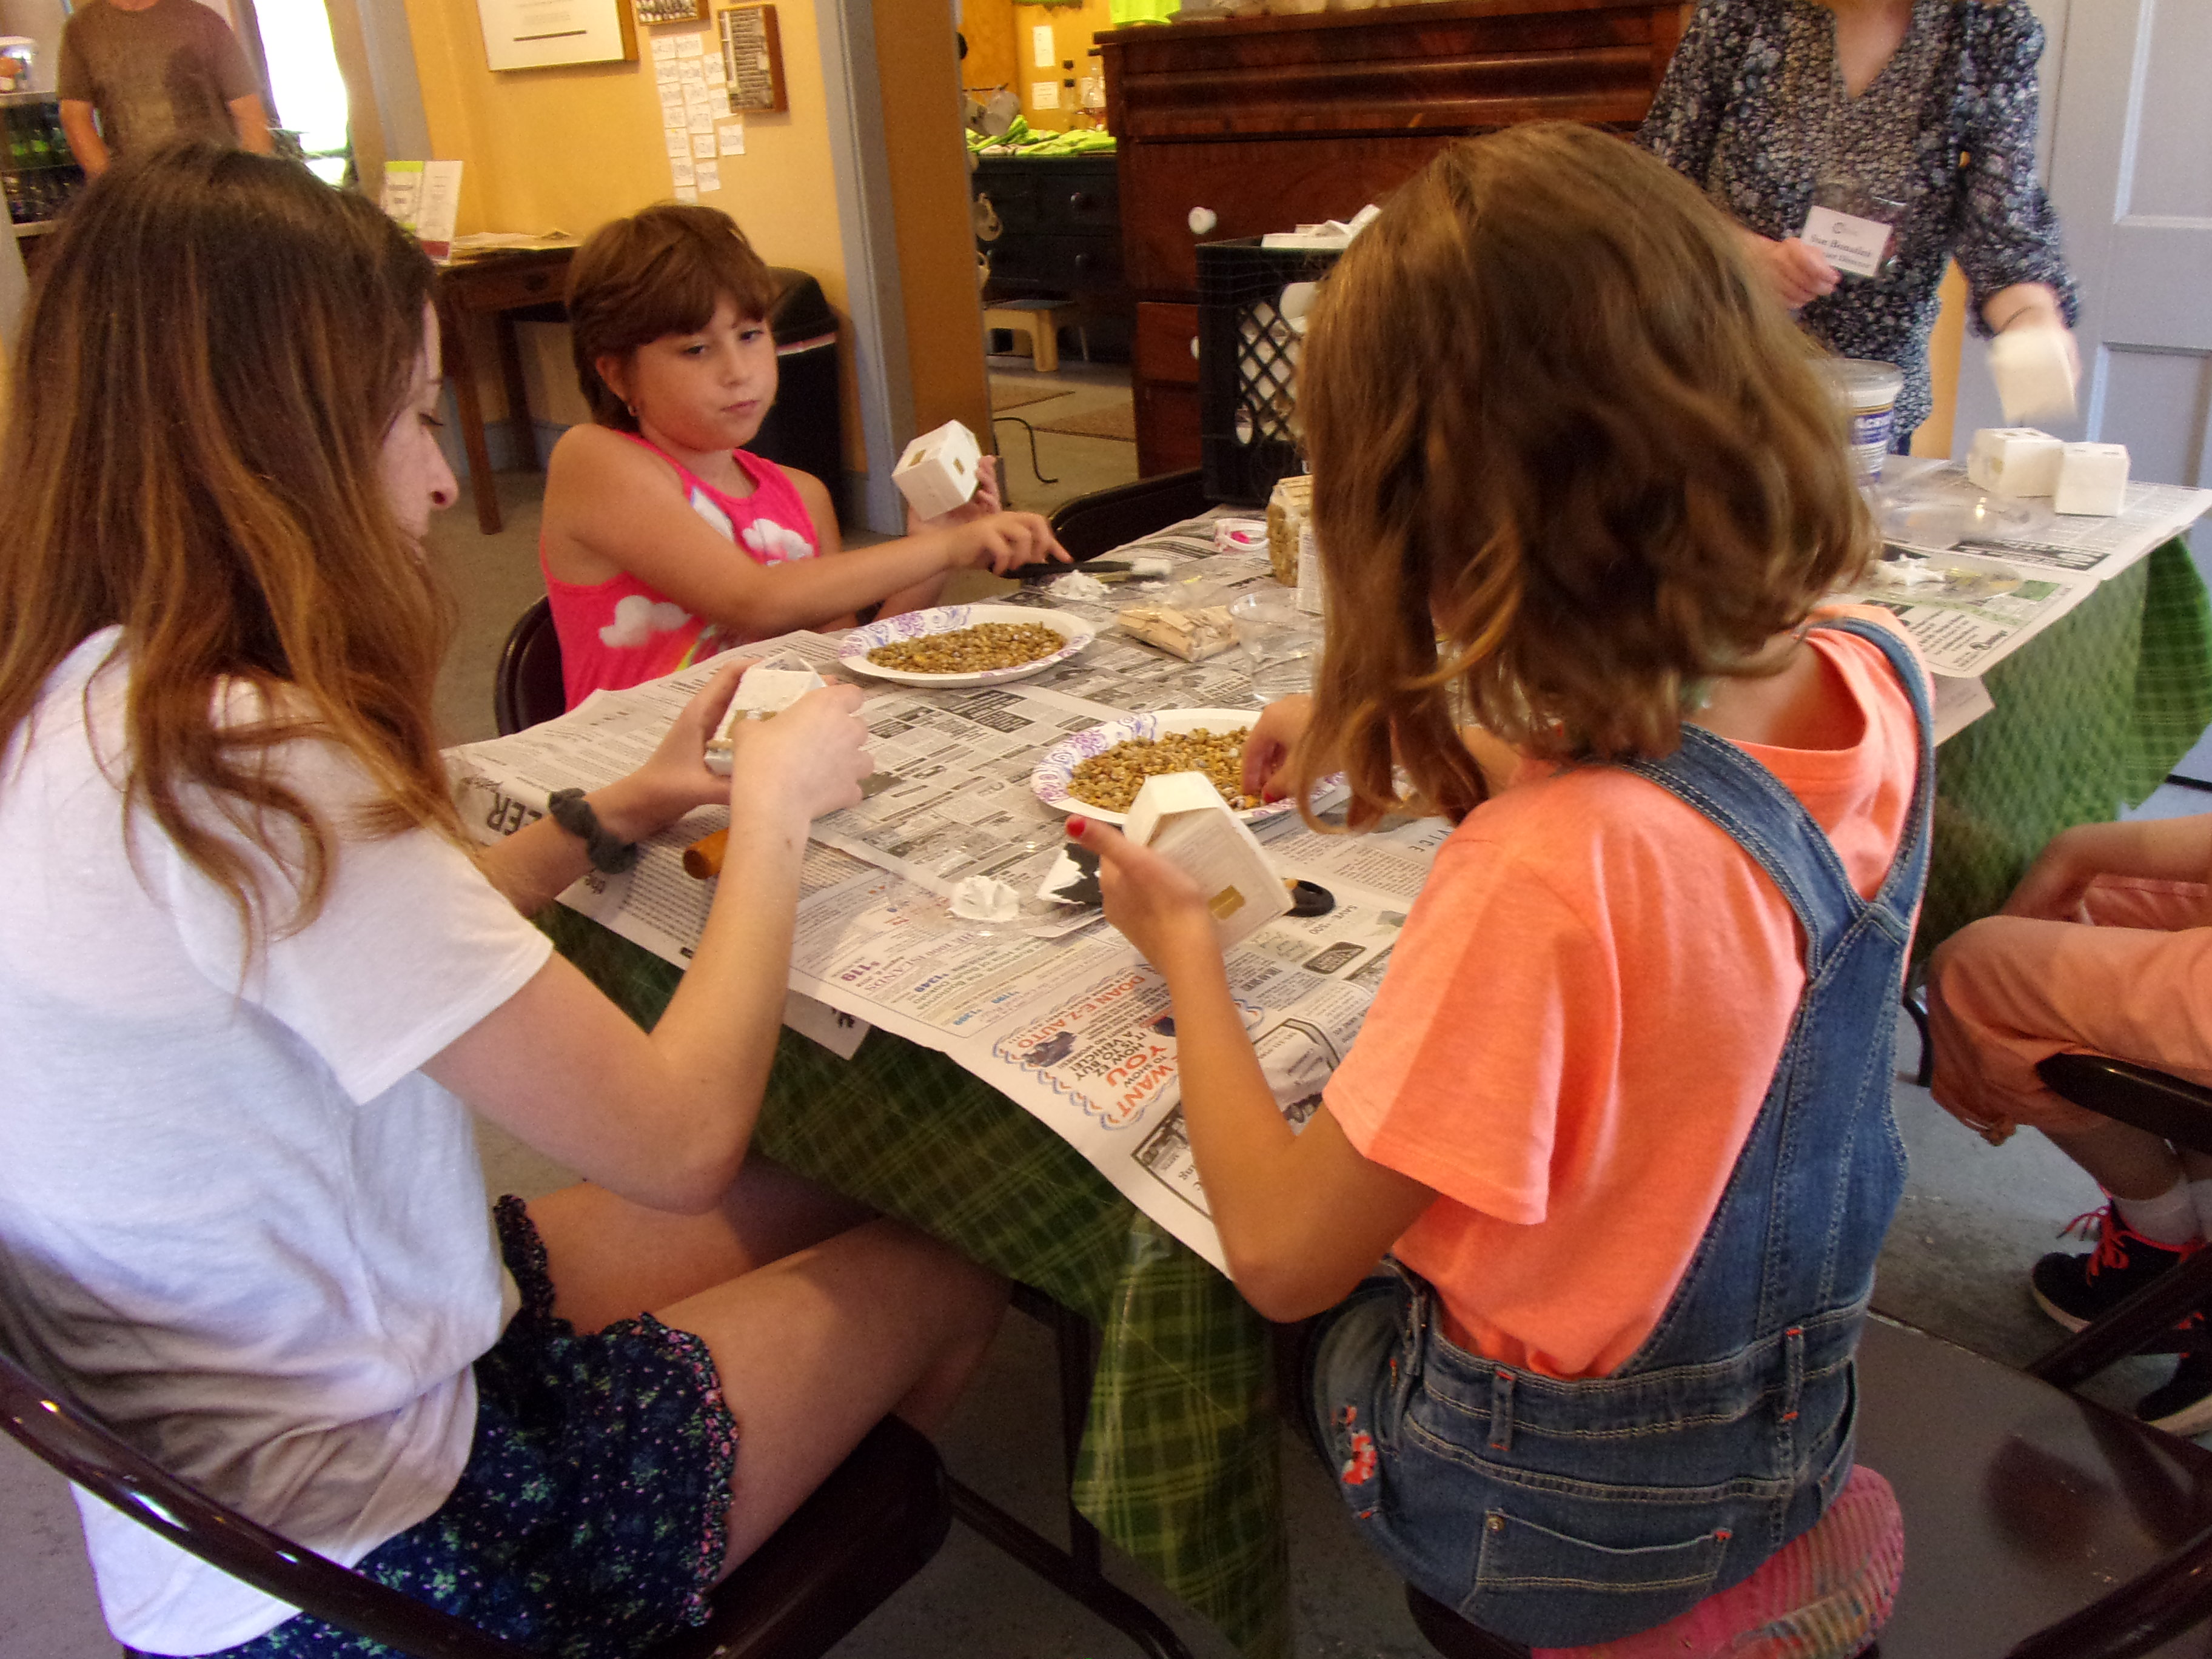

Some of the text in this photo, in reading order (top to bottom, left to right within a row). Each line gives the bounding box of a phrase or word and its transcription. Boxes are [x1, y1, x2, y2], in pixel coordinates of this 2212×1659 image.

[1332, 905, 1358, 920] SAVE
[913, 982, 949, 1003] Dakota
[1095, 974, 1145, 1004] DOAN
[1017, 1018, 1067, 1049] AUTO
[1068, 1039, 1122, 1072] VEHICLE!
[1075, 1032, 1146, 1081] IT IS TO BUY
[1091, 1042, 1144, 1077] HOW EZ
[1107, 1045, 1167, 1087] YOU
[1124, 1054, 1167, 1087] TO SHOW
[1116, 1063, 1173, 1119] WANT
